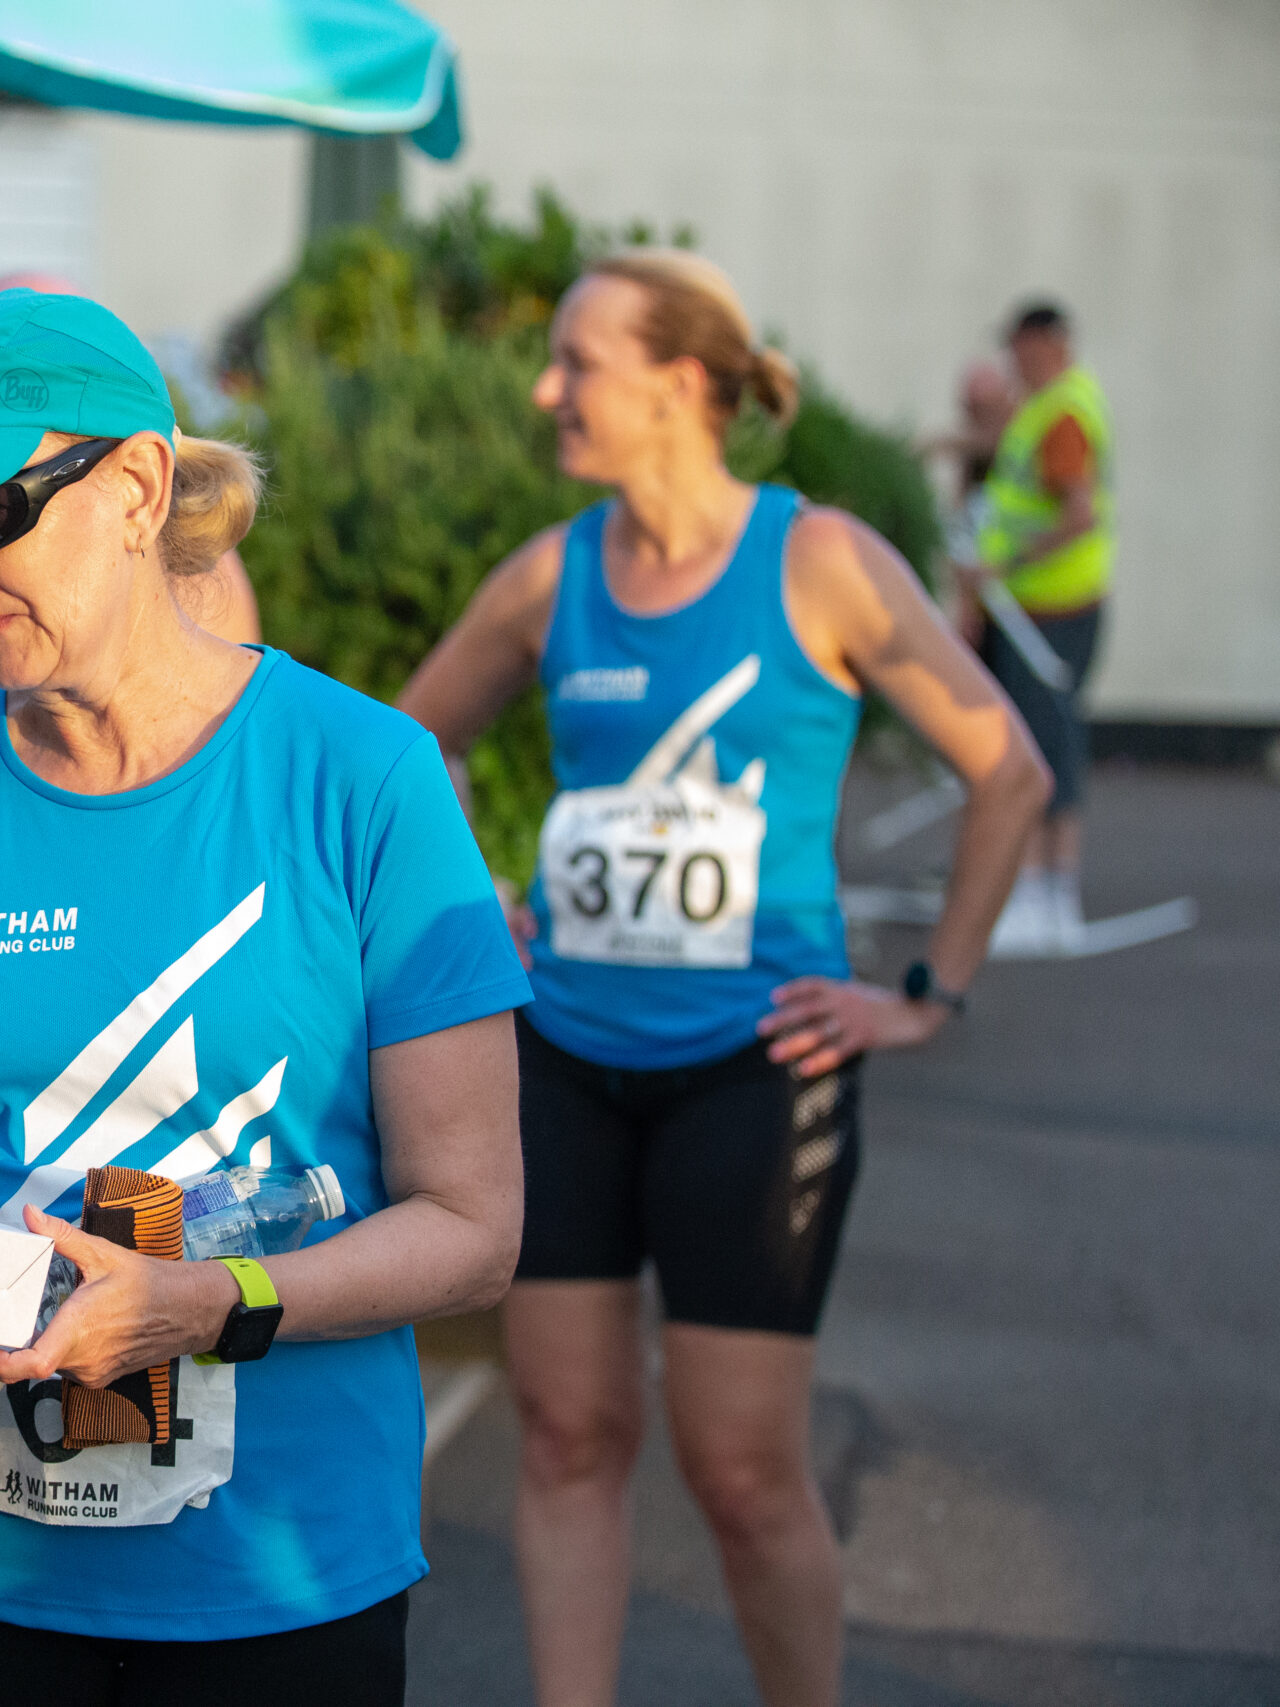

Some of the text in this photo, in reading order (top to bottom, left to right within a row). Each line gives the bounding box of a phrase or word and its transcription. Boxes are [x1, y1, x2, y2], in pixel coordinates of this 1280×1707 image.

[5, 376, 45, 408] Buff
[569, 847, 727, 923] 370
[29, 936, 75, 952] CLUB
[26, 1476, 119, 1502] WITHAM
[27, 1499, 118, 1518] RUNNING CLUB
